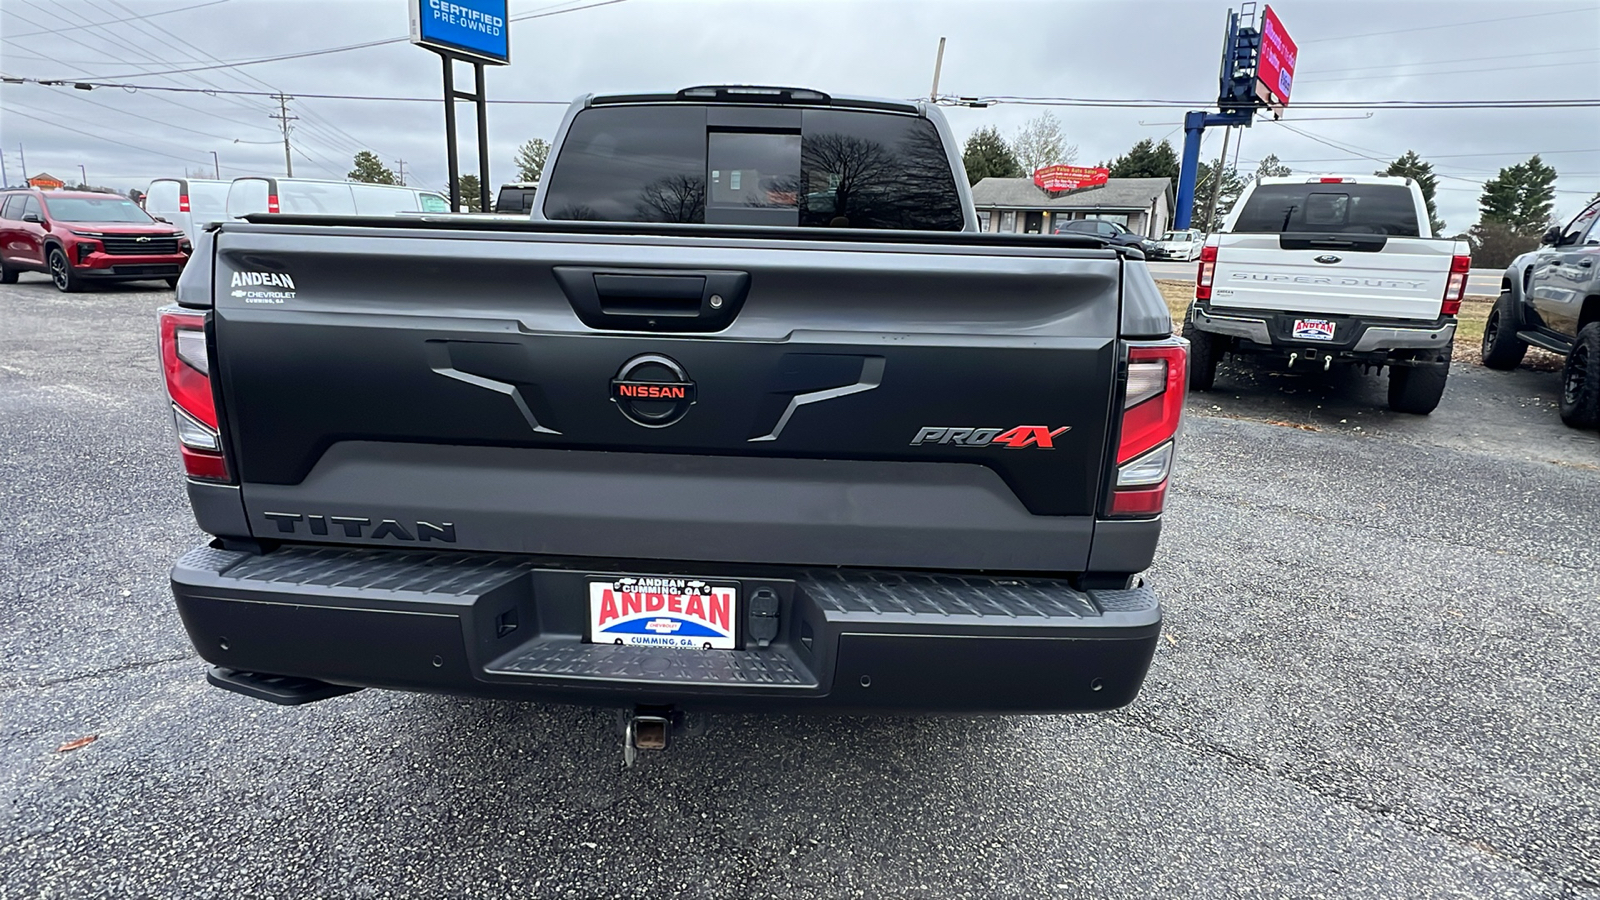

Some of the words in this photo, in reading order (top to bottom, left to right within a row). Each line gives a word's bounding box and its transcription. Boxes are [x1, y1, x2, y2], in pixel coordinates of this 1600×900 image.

[429, 0, 503, 28] CERTIFIED
[433, 10, 500, 37] PRE-OWNED
[230, 271, 296, 289] ANDEAN
[1232, 273, 1332, 285] SUPER
[1341, 278, 1426, 289] DUTY
[247, 291, 297, 299] CHEVROLET
[1295, 321, 1334, 334] ANDEAN
[620, 385, 685, 398] NISSAN
[264, 511, 457, 543] TITAN
[638, 578, 685, 588] ANDEAN
[622, 585, 682, 595] CUMMING,
[684, 588, 701, 596] GA
[598, 589, 730, 632] ANDEAN
[631, 636, 678, 646] CUMMING,
[680, 638, 697, 646] GA.
